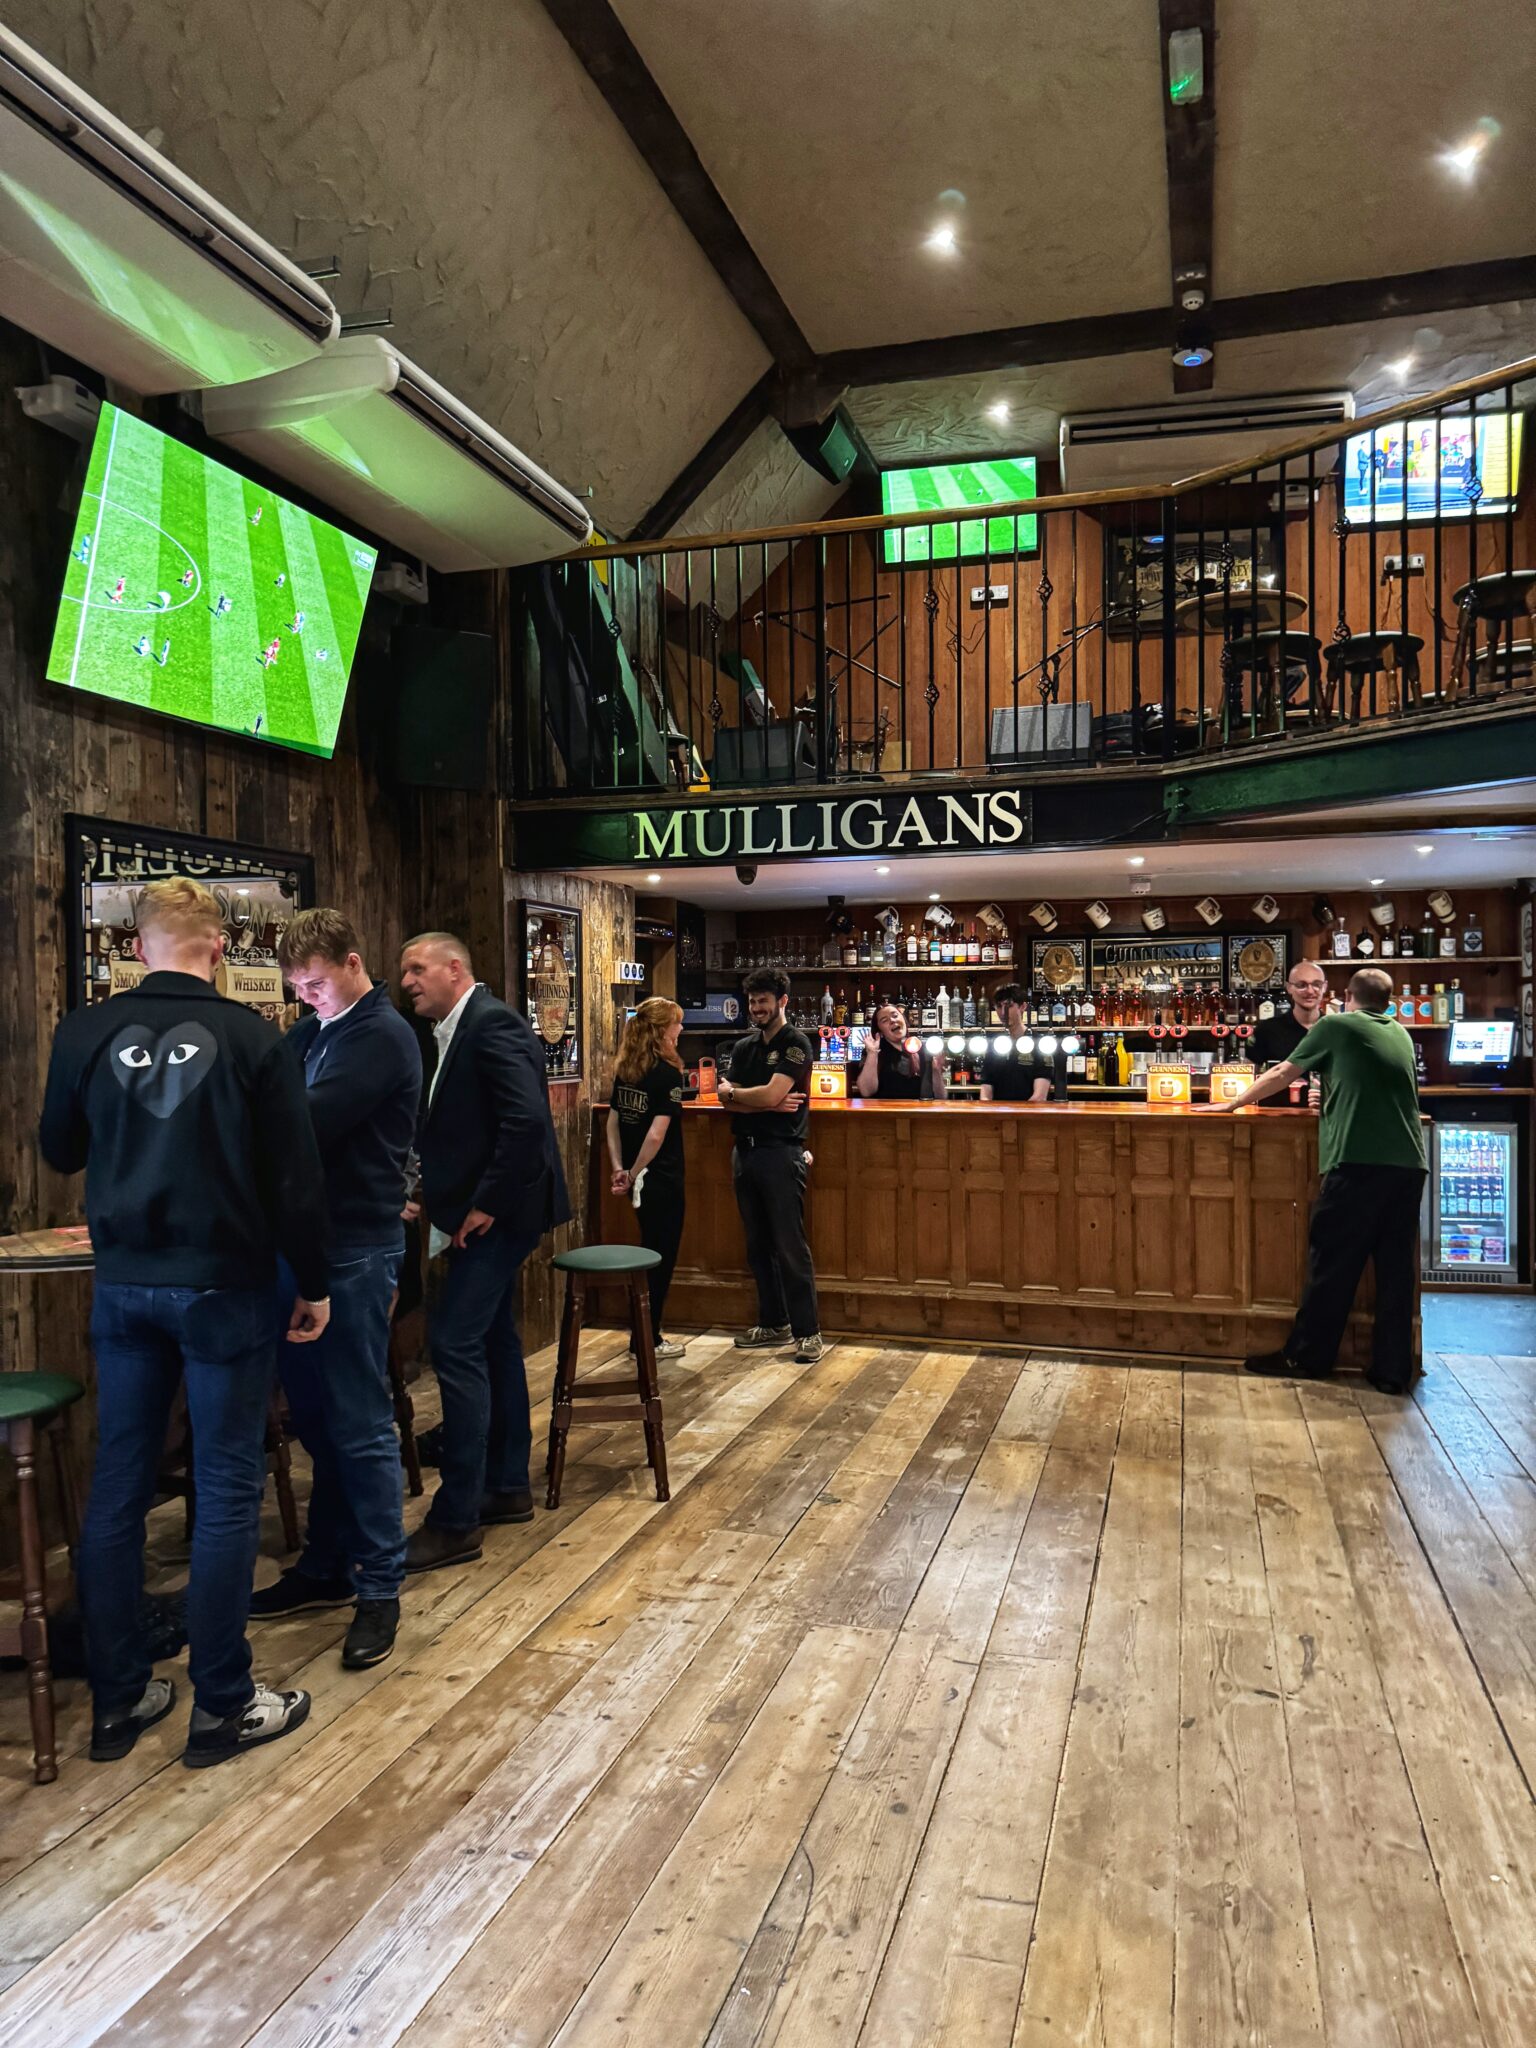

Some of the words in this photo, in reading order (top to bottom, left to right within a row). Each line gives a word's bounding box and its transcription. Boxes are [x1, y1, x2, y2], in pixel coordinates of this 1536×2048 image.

[634, 790, 1023, 859] MULLIGANS
[122, 885, 271, 940] JSON
[233, 972, 277, 992] WHISKEY
[537, 980, 569, 999] GUINNESS
